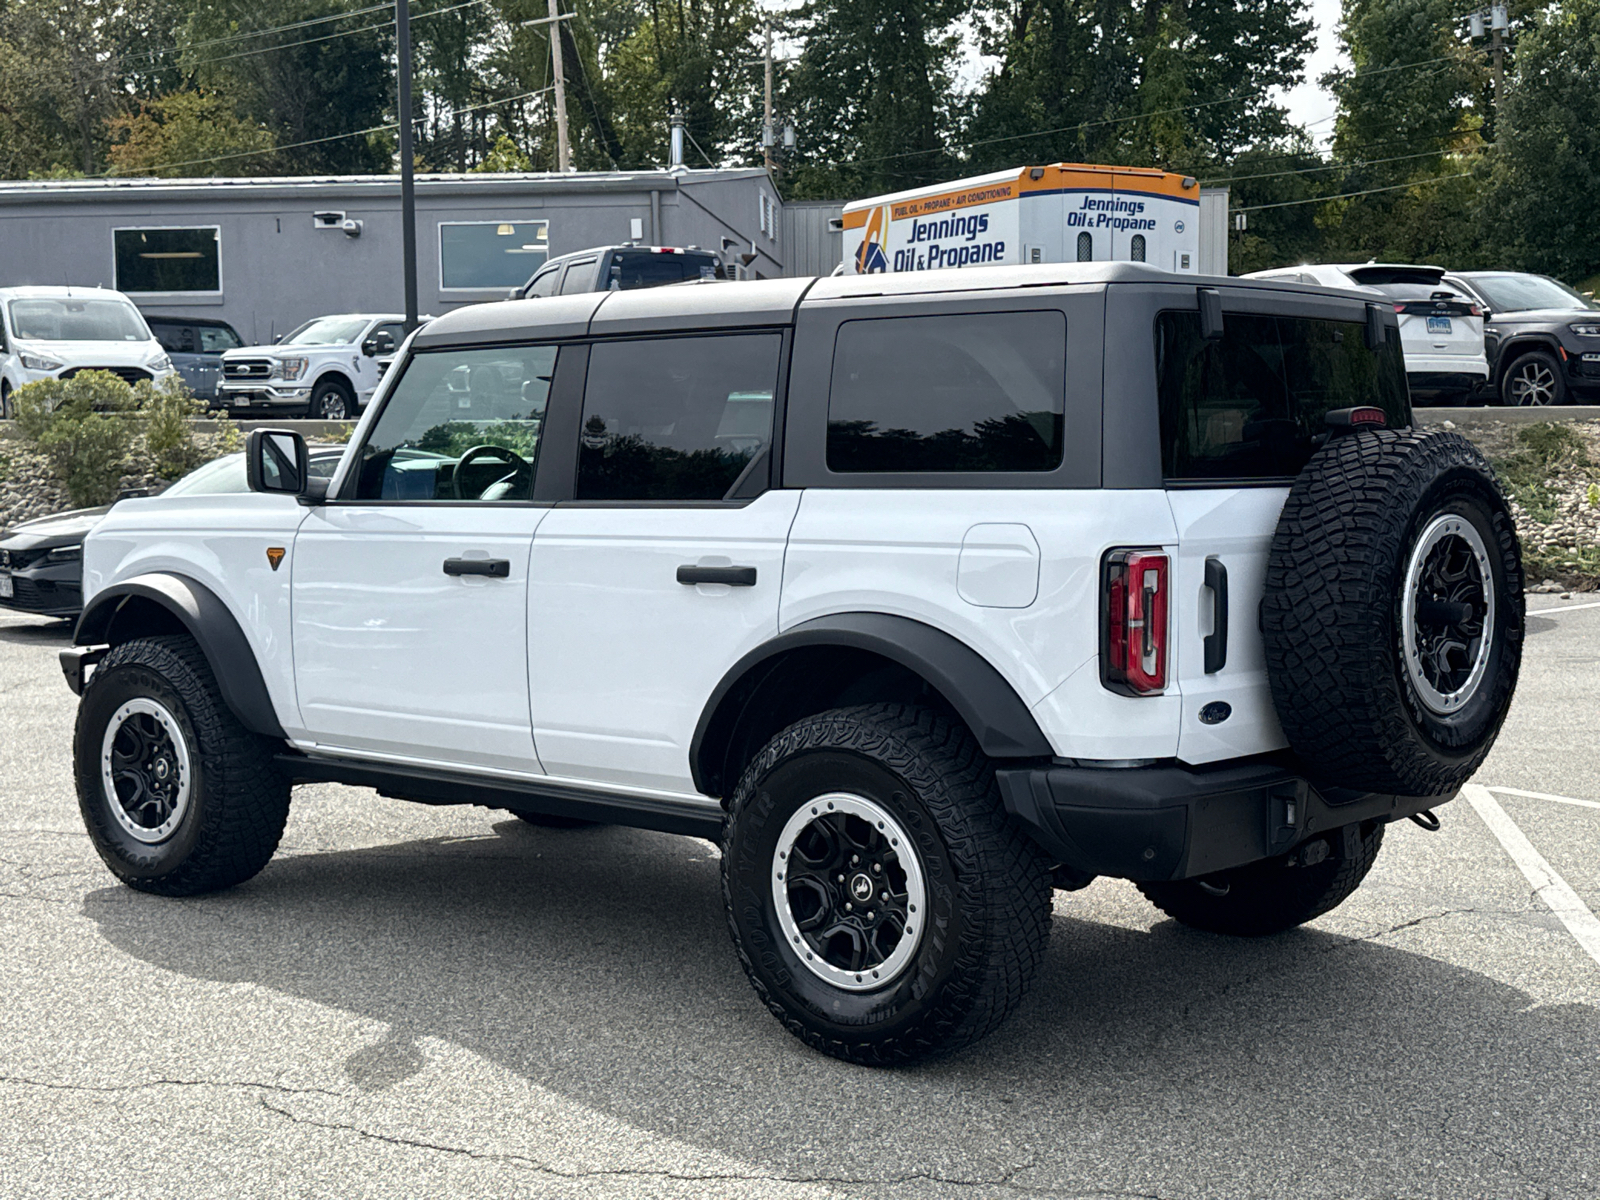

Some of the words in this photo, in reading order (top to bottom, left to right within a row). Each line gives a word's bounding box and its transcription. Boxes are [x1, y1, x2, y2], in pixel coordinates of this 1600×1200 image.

[895, 207, 908, 217] FUEL
[909, 205, 918, 214] OIL
[924, 198, 951, 211] PROPANE
[956, 195, 966, 205] AIR
[967, 186, 1011, 203] CONDITIONING
[1079, 195, 1145, 216] Jennings
[907, 212, 989, 244] Jennings
[1067, 212, 1087, 227] Oil
[1087, 217, 1095, 227] &
[1096, 213, 1156, 232] Propane
[894, 247, 916, 272] Oil
[917, 254, 926, 271] &
[927, 241, 1005, 270] Propane
